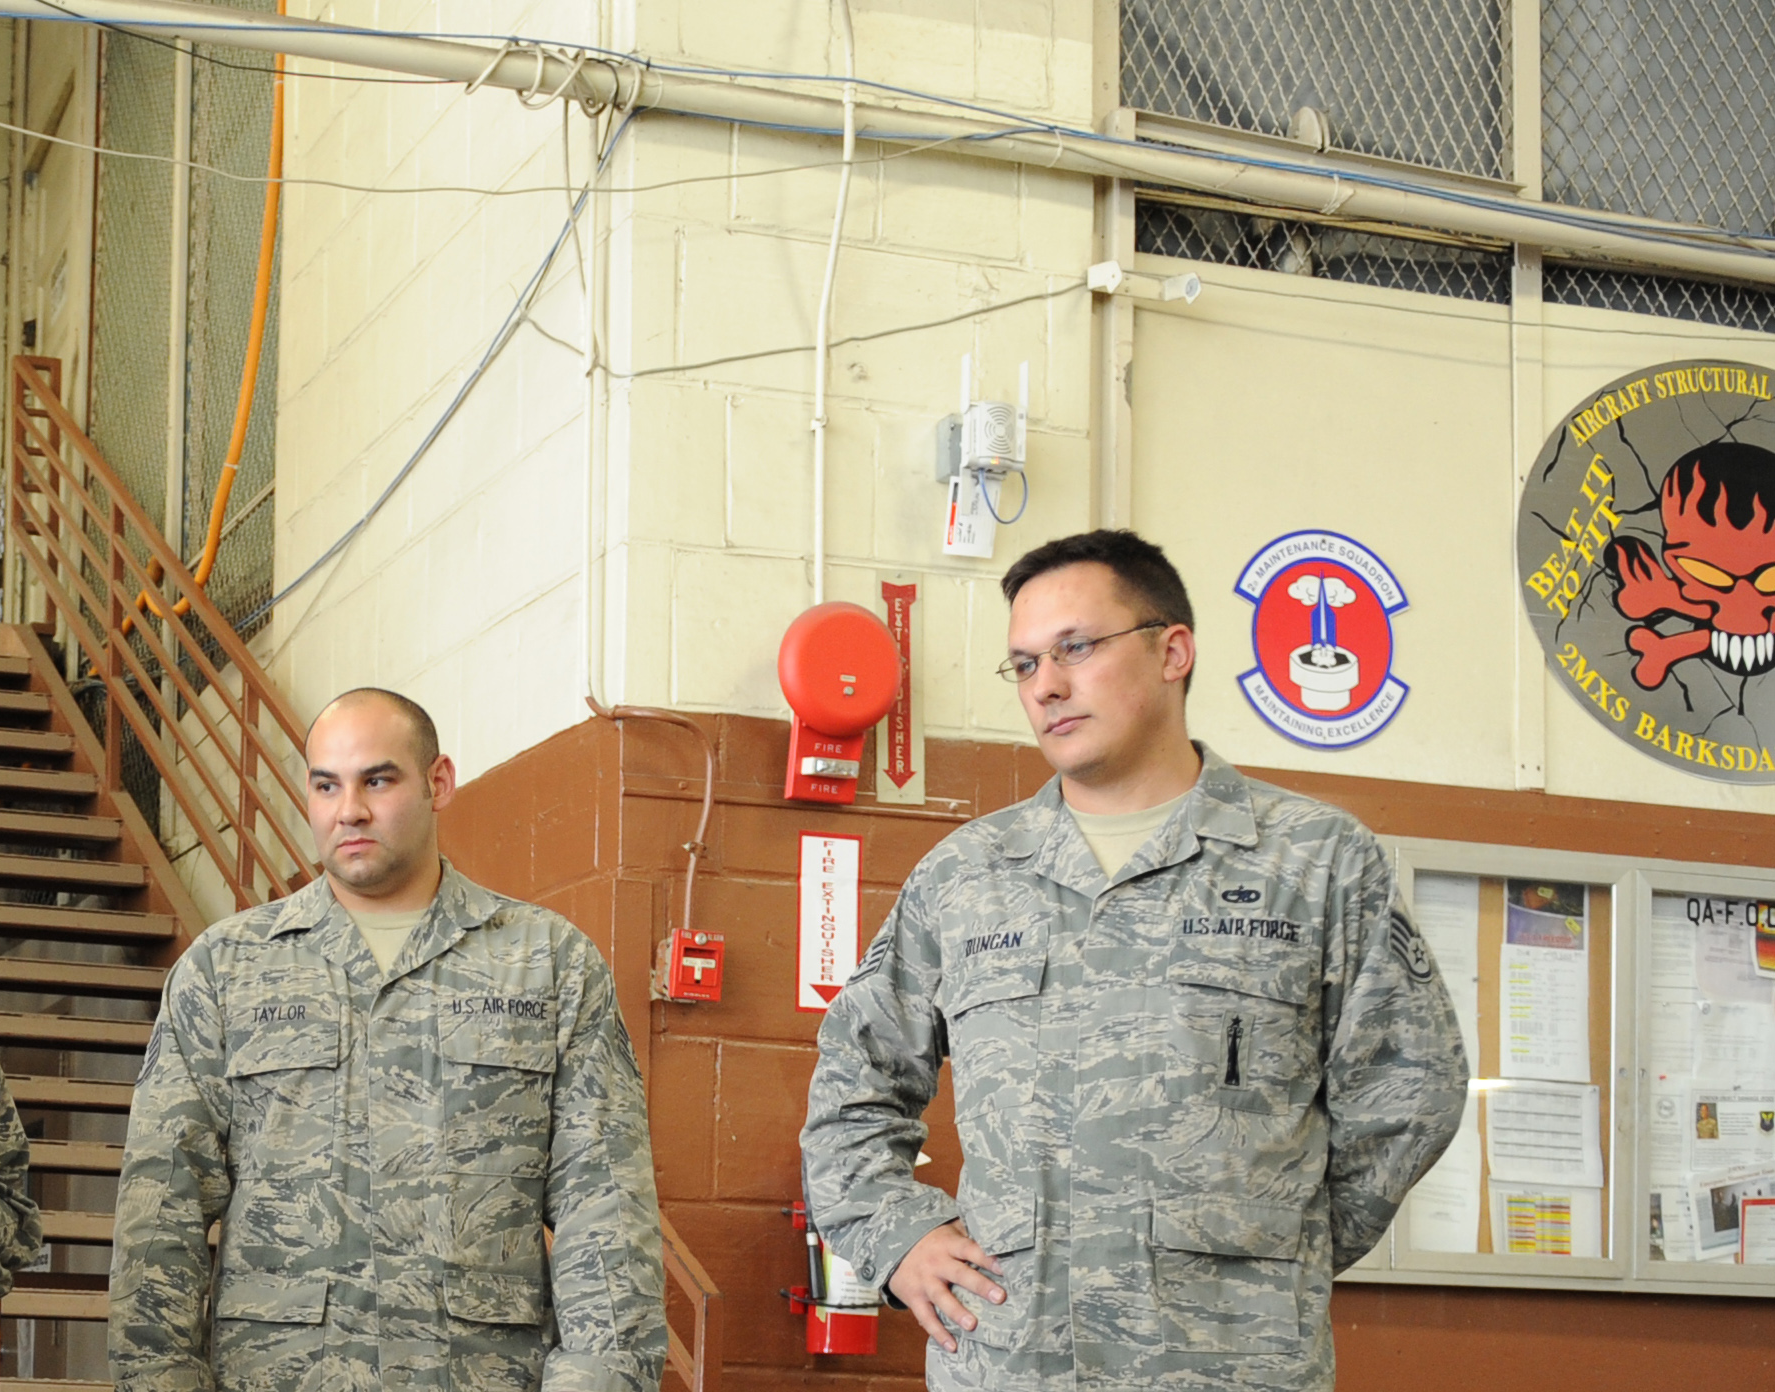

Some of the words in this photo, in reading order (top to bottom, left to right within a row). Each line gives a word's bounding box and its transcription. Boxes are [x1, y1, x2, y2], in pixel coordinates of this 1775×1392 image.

[1567, 379, 1652, 448] AIRCRAFT
[1653, 366, 1772, 400] STRUCTURAL
[1525, 506, 1584, 600] BEAT
[1579, 451, 1616, 510] IT
[1255, 541, 1335, 579] MAINTENANCE
[1338, 546, 1397, 601] SQUADRON
[1545, 573, 1581, 621] TO
[1575, 495, 1623, 569] FIT
[1555, 642, 1631, 723] 2MXS
[1253, 684, 1323, 738] MAINTAINING
[1327, 691, 1395, 738] EXCELLENCE
[813, 742, 843, 754] FIRE
[810, 783, 839, 794] FIRE
[822, 840, 835, 874] FIRE
[820, 881, 836, 982] EXTINGUISHER
[965, 931, 1024, 958] DUNCAN
[1183, 917, 1216, 935] U.S.
[1216, 917, 1245, 936] AIR
[1248, 918, 1301, 943] FORCE
[252, 1004, 306, 1022] TAYLOR
[452, 999, 477, 1015] U.S.
[482, 998, 505, 1014] AIR
[508, 999, 548, 1020] FORCE
